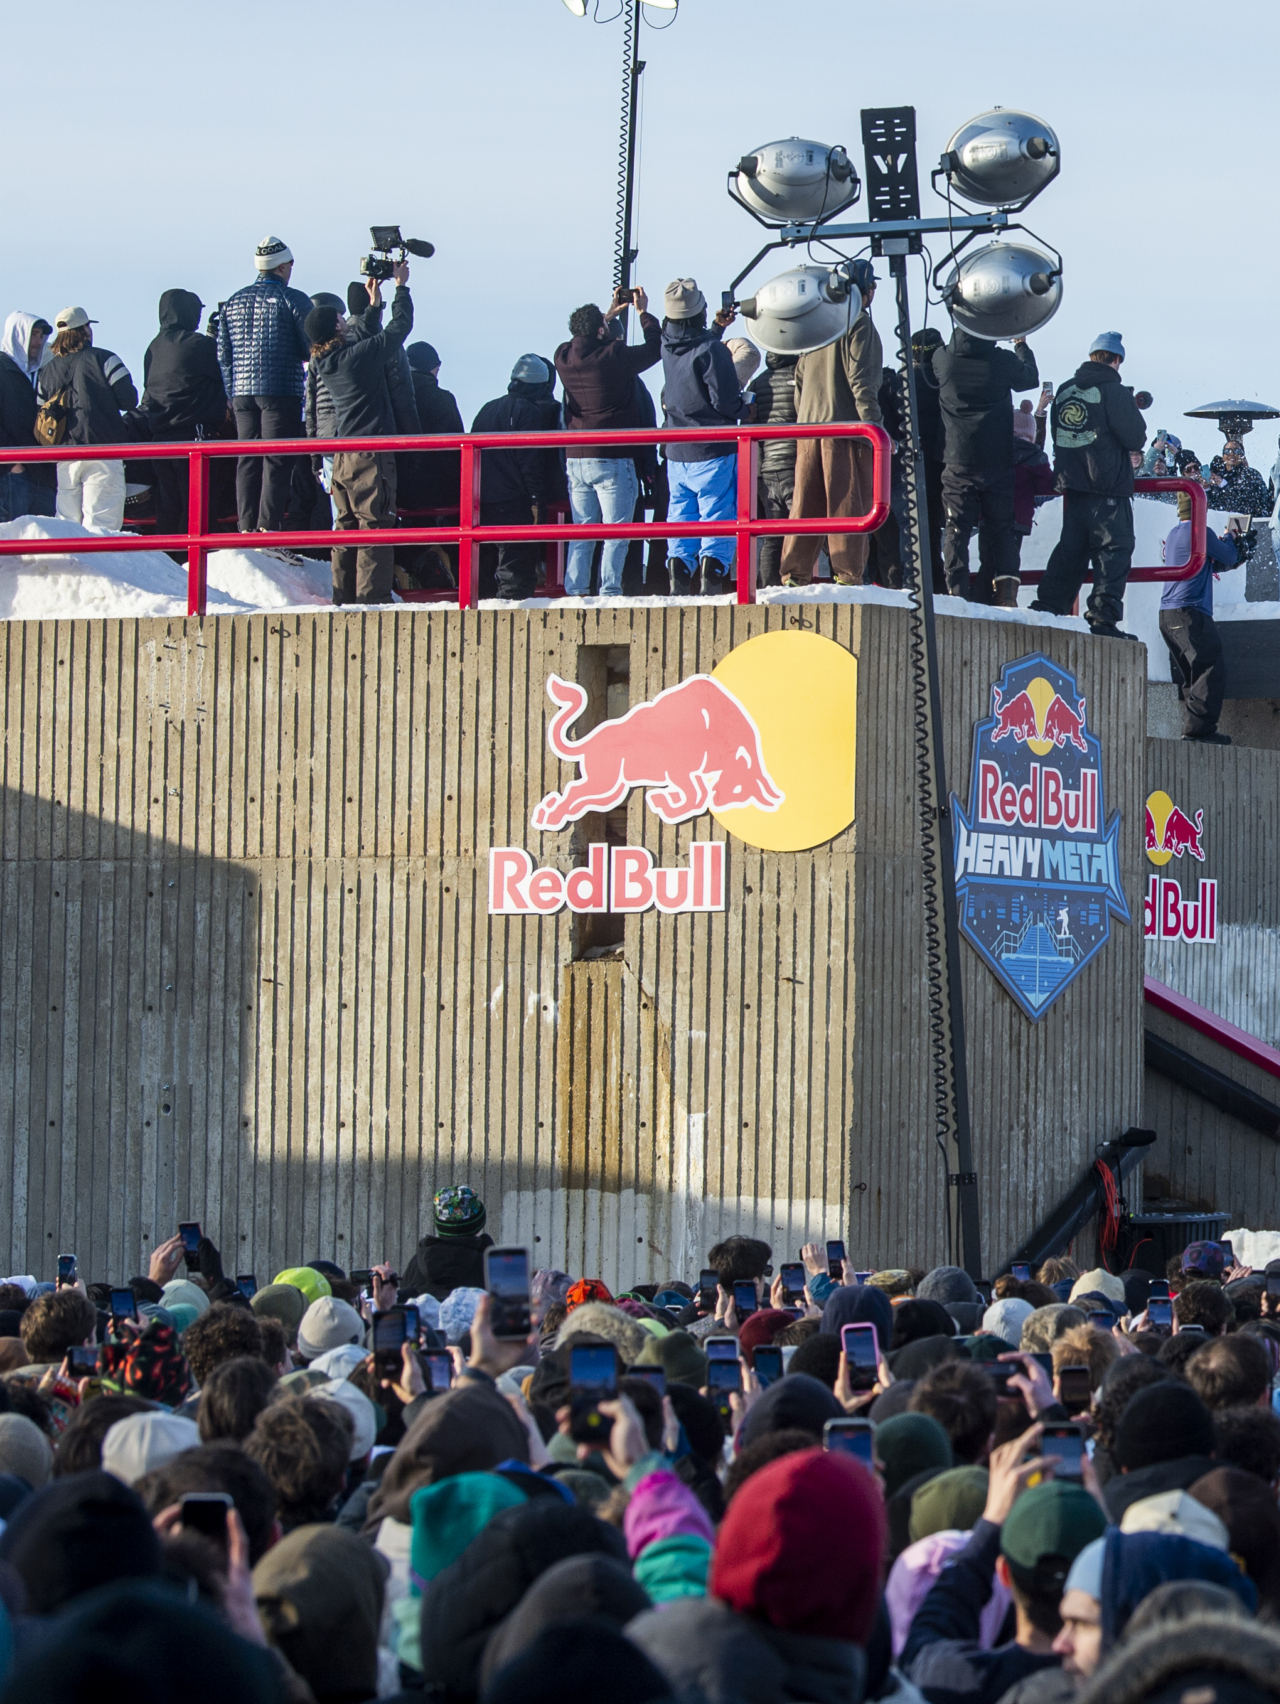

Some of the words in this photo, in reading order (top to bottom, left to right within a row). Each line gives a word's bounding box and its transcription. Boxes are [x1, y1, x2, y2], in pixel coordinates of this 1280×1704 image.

[261, 245, 283, 255] COAL
[980, 762, 1038, 824] Red
[1043, 769, 1096, 830] Bull
[493, 847, 604, 910] Red
[614, 845, 722, 909] Bull
[956, 818, 1041, 882] HEAVY
[1042, 833, 1122, 905] METAL
[1162, 880, 1215, 940] Bull
